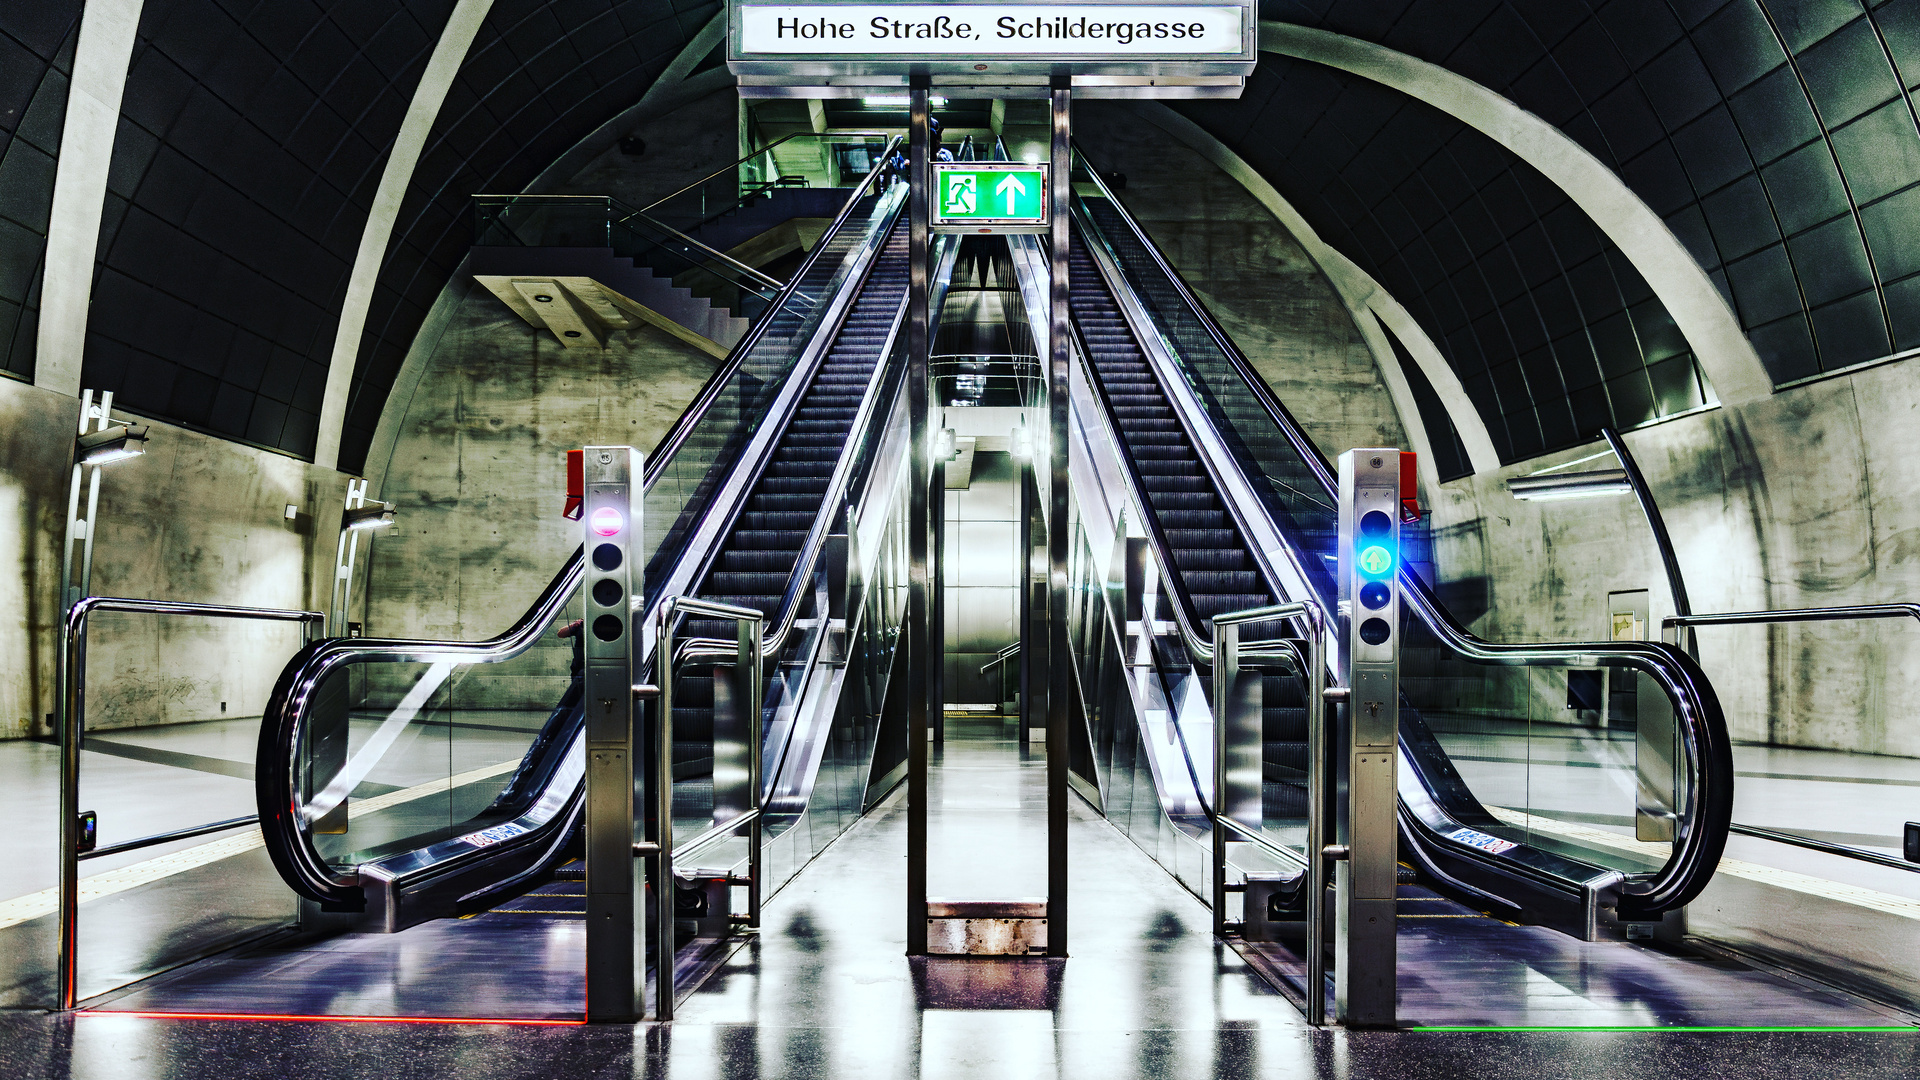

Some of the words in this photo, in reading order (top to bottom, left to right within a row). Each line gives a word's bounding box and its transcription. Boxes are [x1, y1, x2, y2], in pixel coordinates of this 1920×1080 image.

[777, 17, 855, 39] Hohe
[870, 16, 980, 41] Straße,
[996, 16, 1205, 45] Schildergasse
